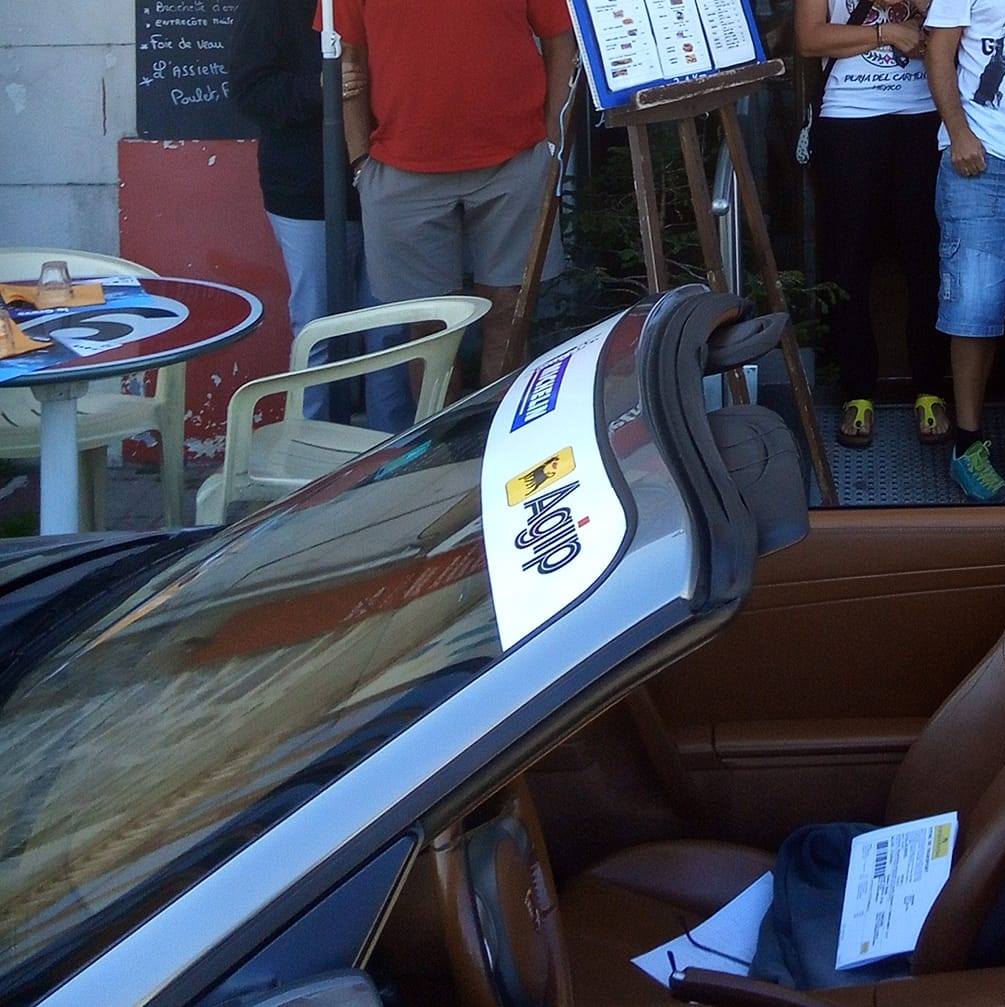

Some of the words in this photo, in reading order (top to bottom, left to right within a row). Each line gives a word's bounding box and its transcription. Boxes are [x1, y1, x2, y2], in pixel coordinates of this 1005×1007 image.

[178, 36, 192, 49] de
[872, 73, 891, 82] DEL
[514, 480, 590, 575] Agip
